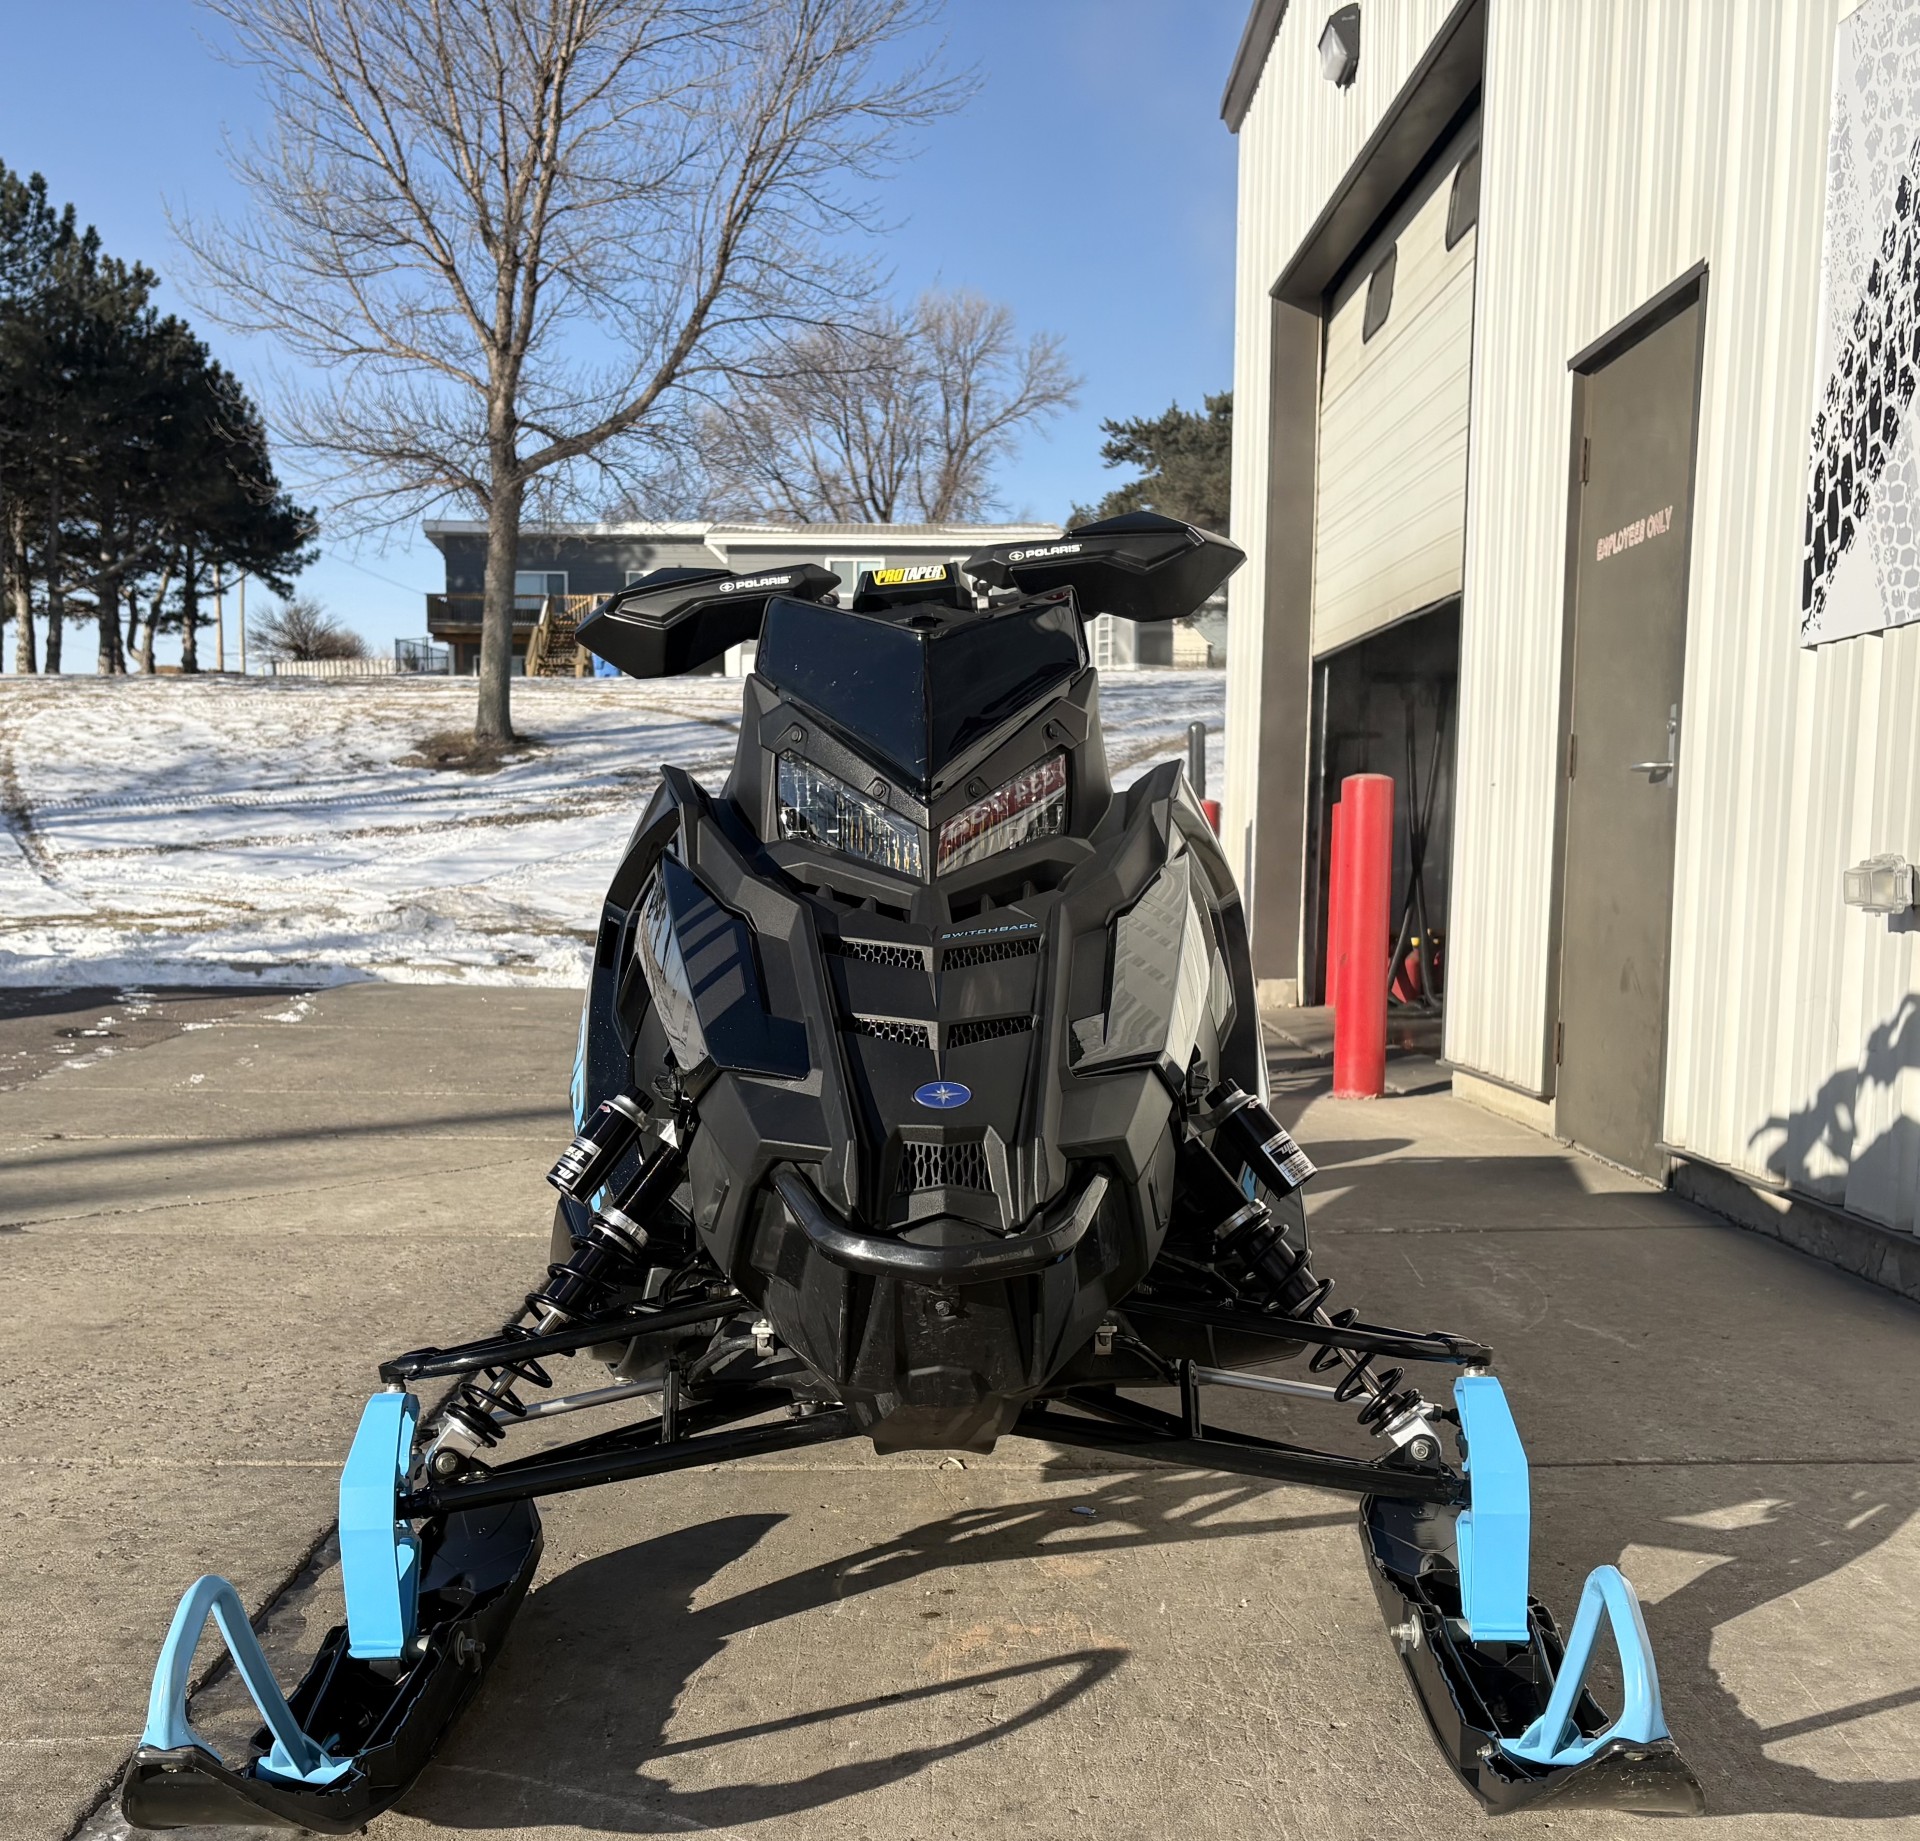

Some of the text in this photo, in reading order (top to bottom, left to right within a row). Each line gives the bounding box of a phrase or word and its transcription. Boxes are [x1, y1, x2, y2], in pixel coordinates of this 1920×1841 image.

[1646, 505, 1673, 538] ONLY
[1025, 544, 1081, 558] POLARIS
[736, 576, 790, 589] POLARIS
[941, 922, 1038, 939] SWITCHBACK
